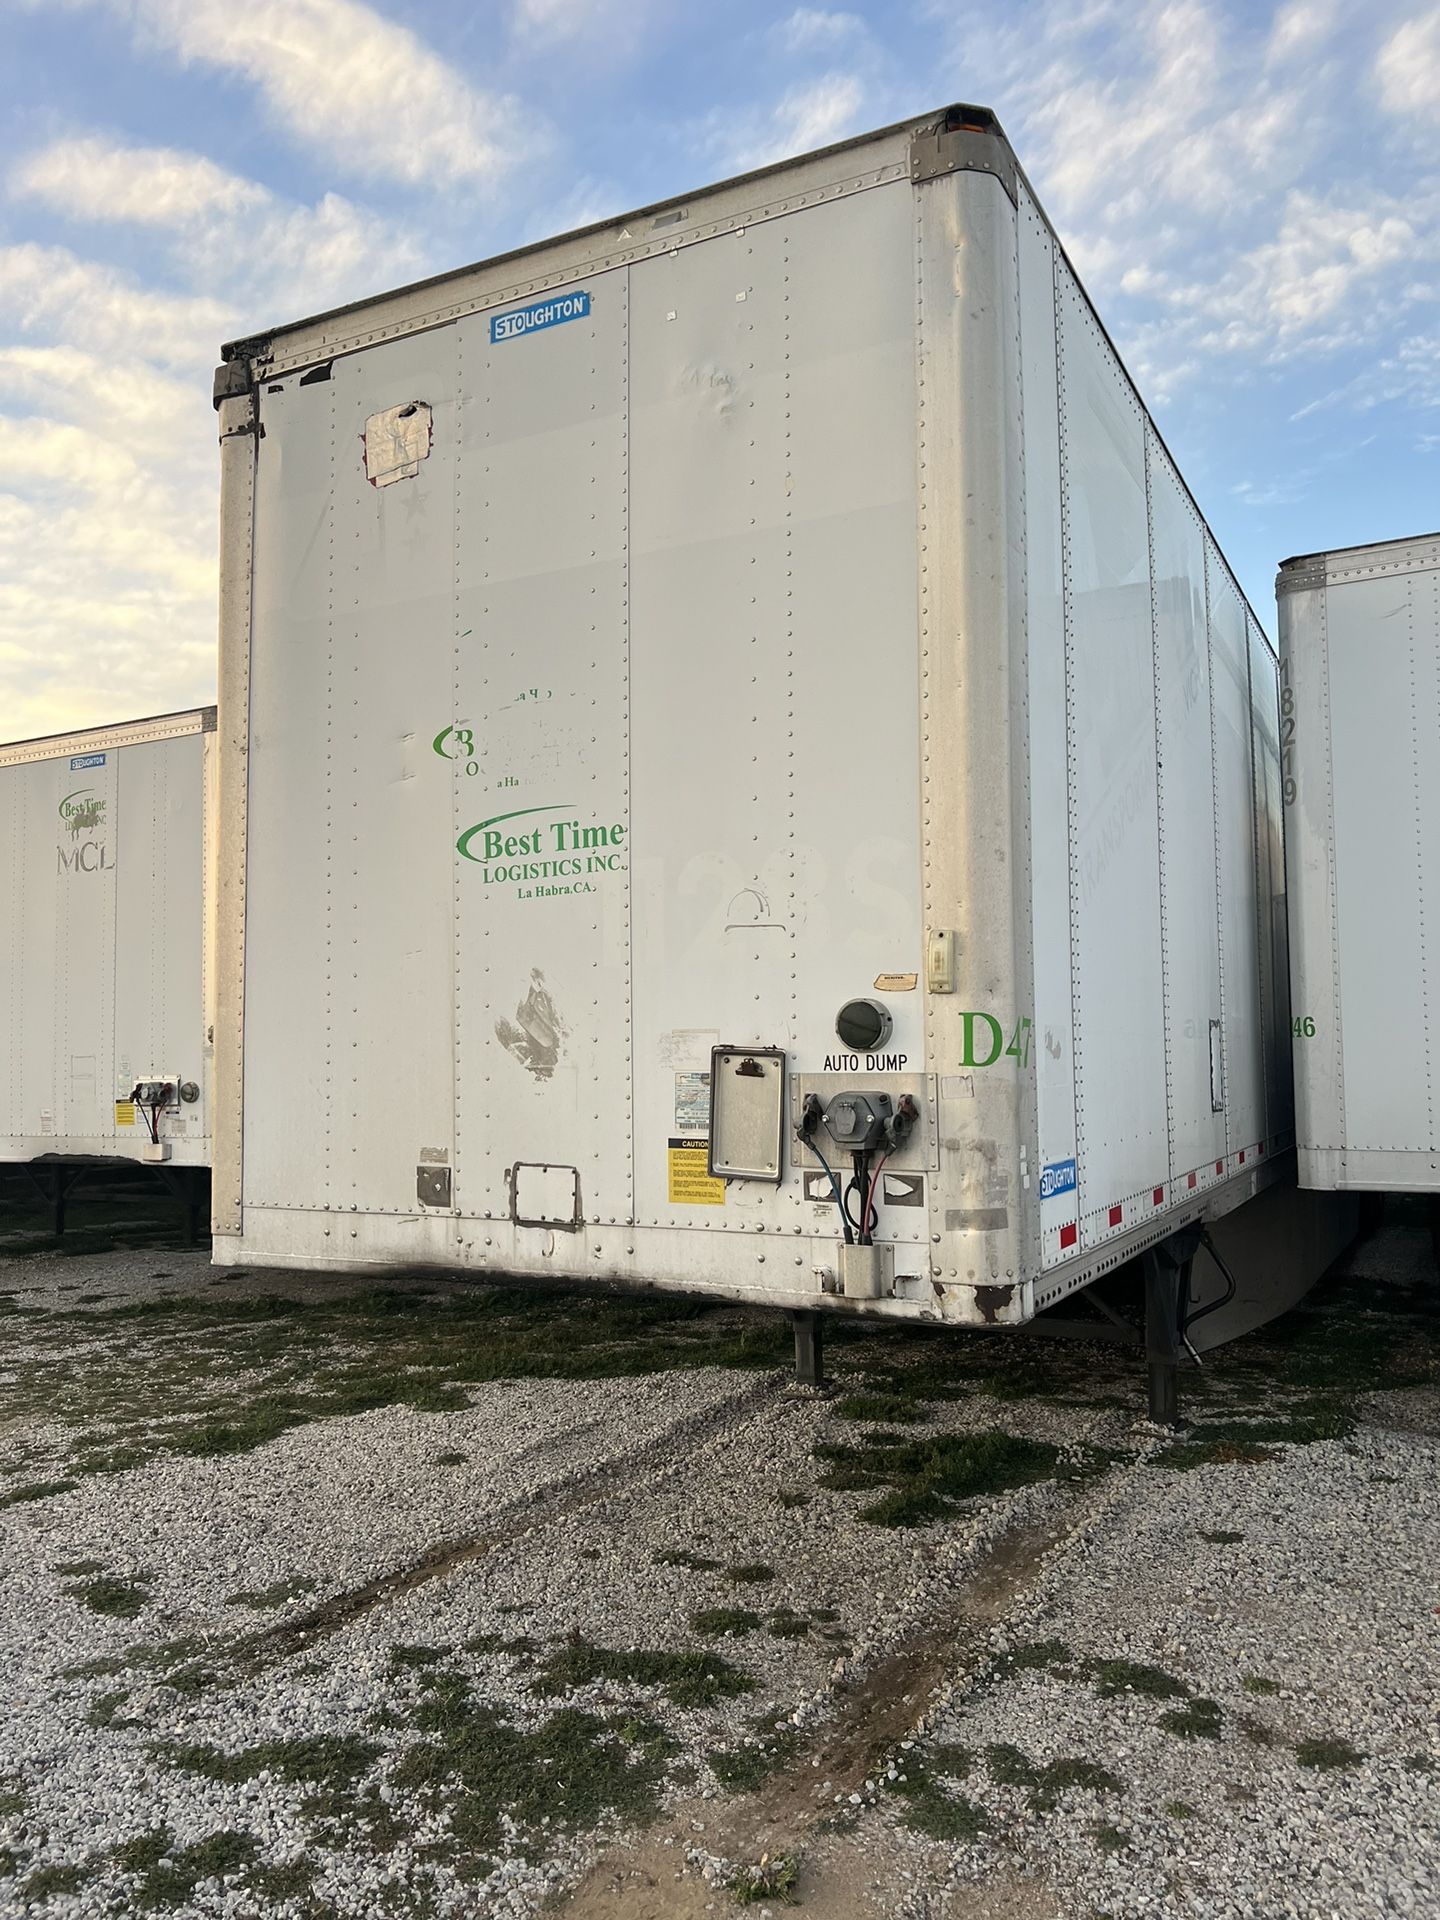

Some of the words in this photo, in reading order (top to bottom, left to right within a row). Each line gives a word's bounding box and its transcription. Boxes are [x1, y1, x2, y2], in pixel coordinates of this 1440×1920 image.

[495, 297, 584, 338] STOUGHTON
[483, 828, 542, 860] Best
[550, 820, 625, 852] Time
[483, 857, 582, 884] LOGISTICS
[518, 888, 532, 899] La
[958, 1012, 1031, 1069] D47
[823, 1054, 859, 1071] AUTO
[866, 1054, 908, 1071] DUMP
